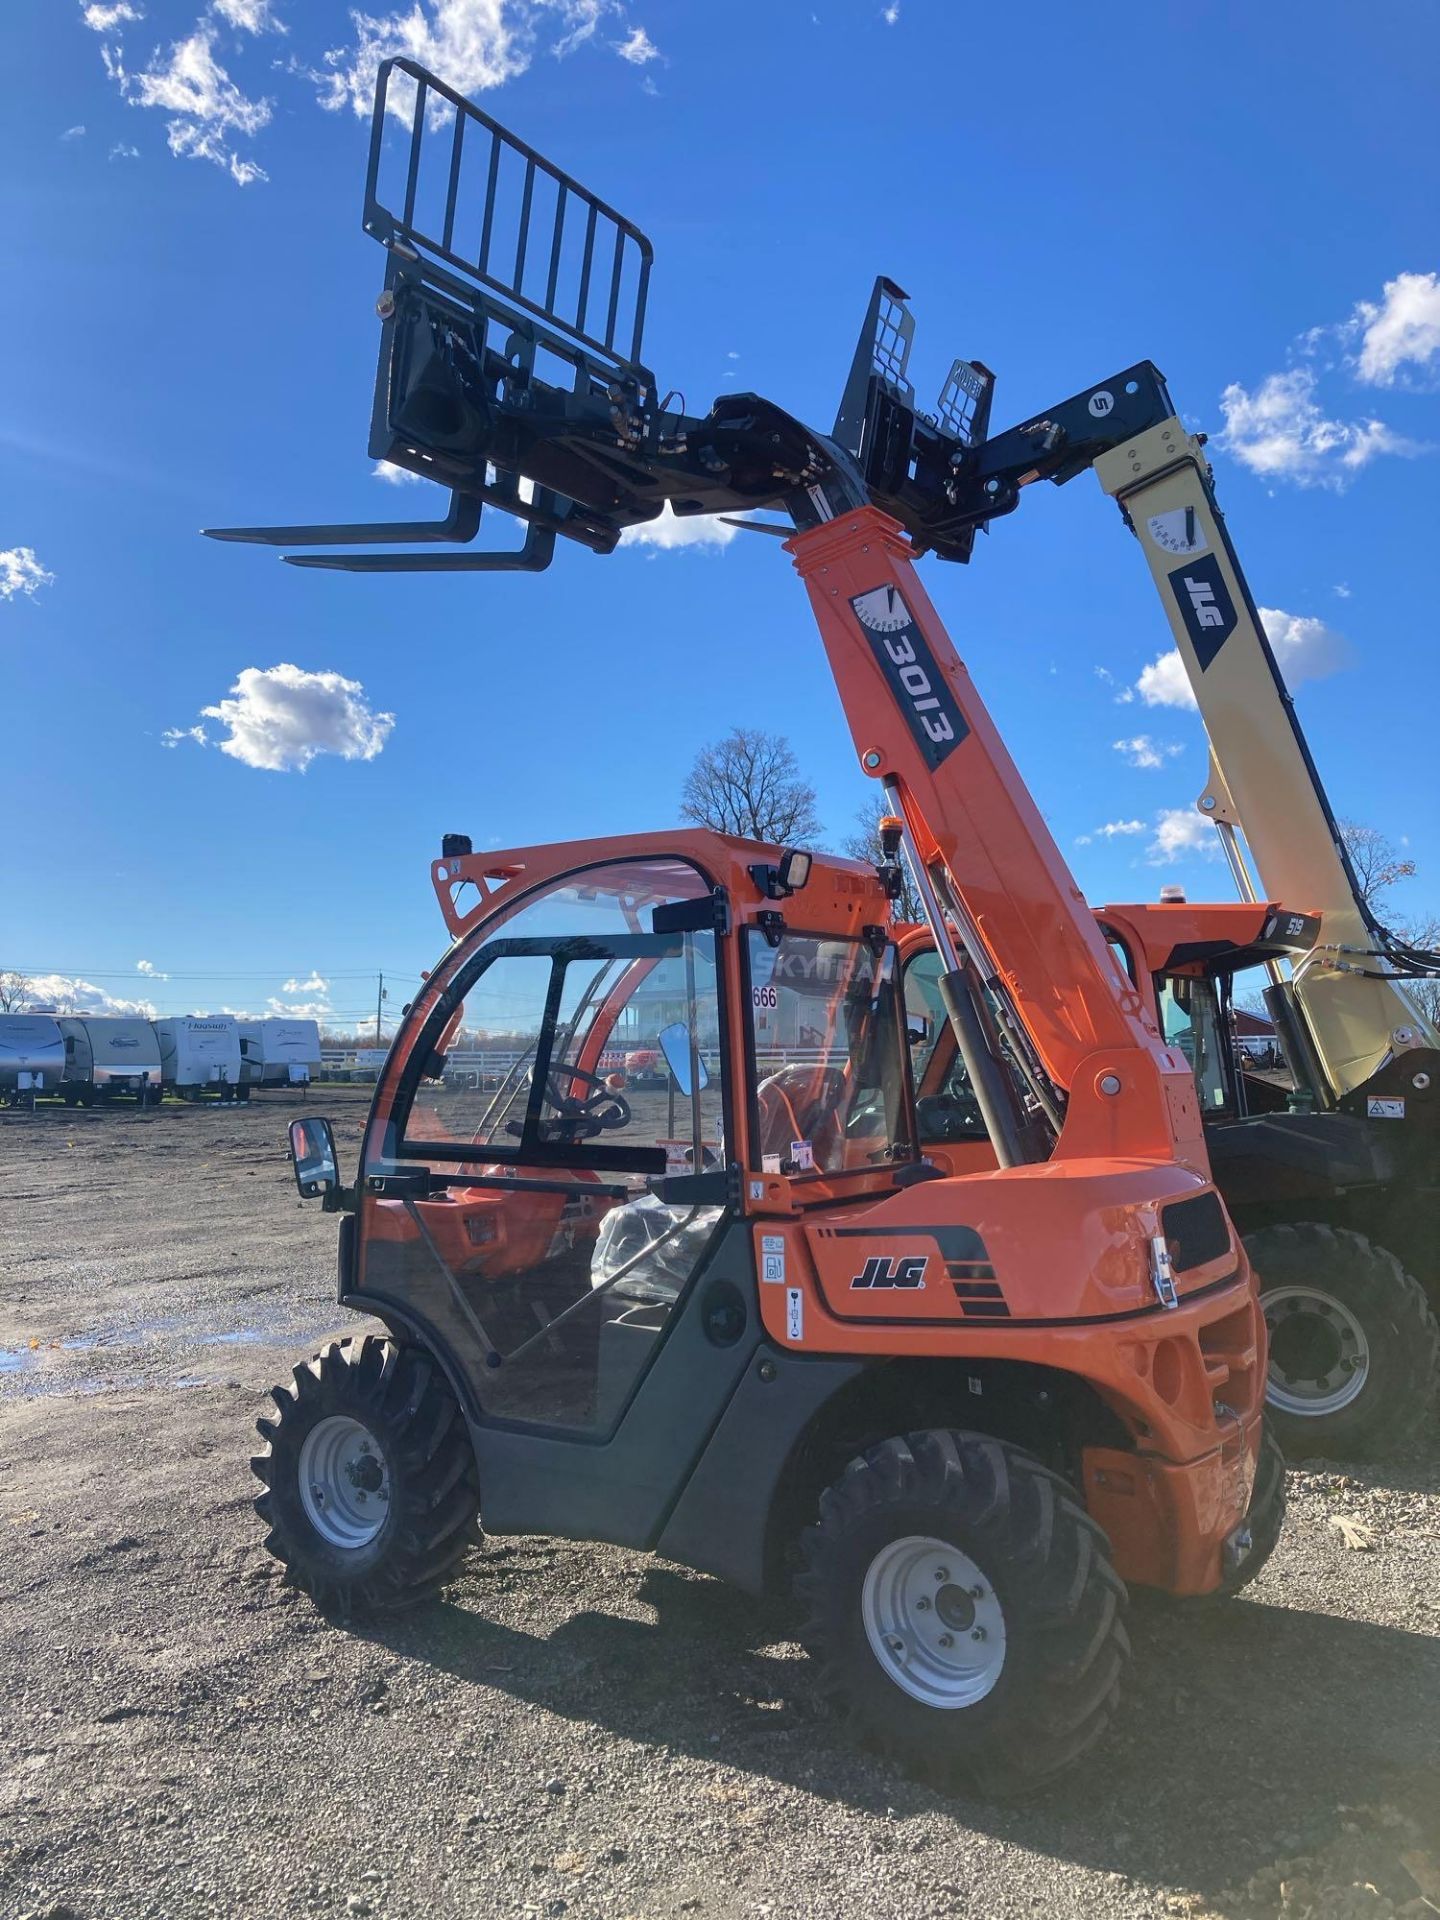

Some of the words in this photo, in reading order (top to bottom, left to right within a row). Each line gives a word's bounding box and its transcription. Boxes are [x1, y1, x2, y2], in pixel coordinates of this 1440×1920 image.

[1183, 577, 1225, 627] JLG
[883, 635, 955, 743] 3013
[753, 987, 777, 1007] 666
[849, 1256, 929, 1290] JLG
